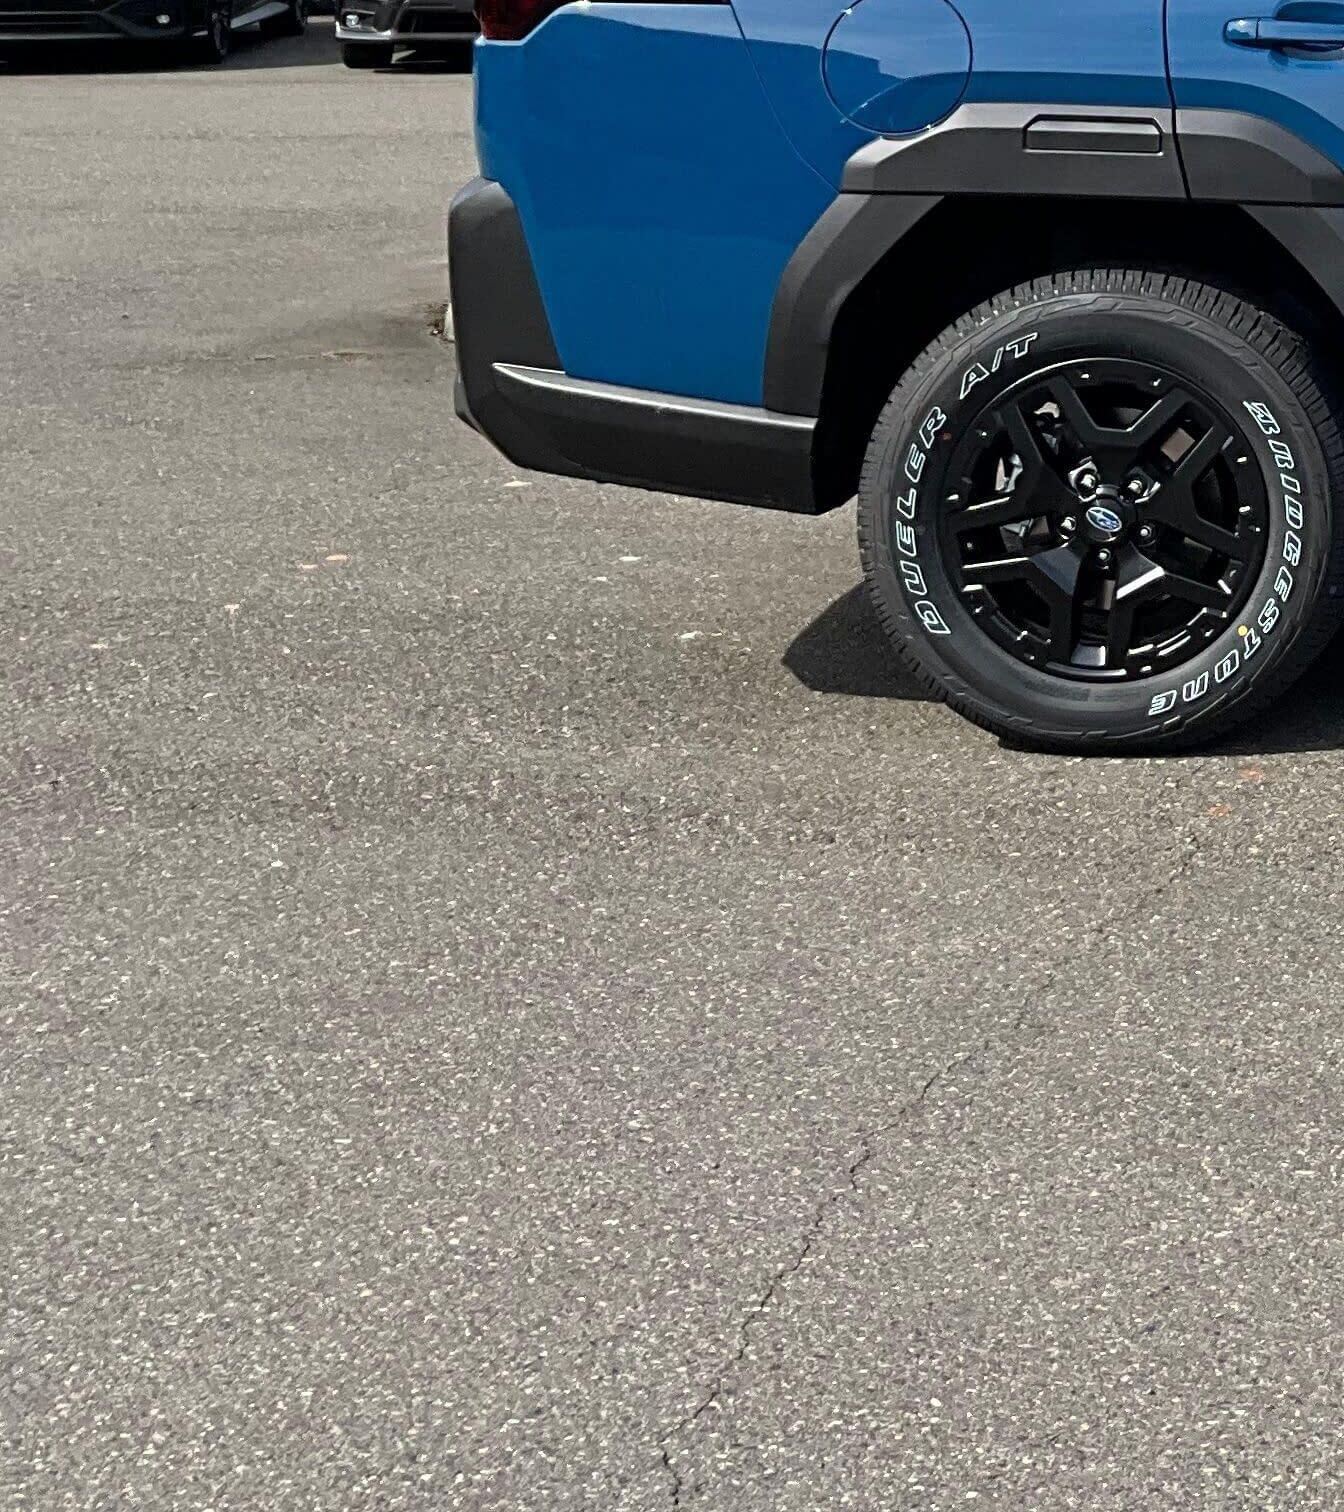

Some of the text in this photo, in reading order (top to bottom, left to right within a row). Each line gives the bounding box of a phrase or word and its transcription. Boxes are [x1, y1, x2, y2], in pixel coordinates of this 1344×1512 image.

[896, 332, 1038, 635] DUELER A/T
[1148, 400, 1302, 716] BRIDGESTONE
